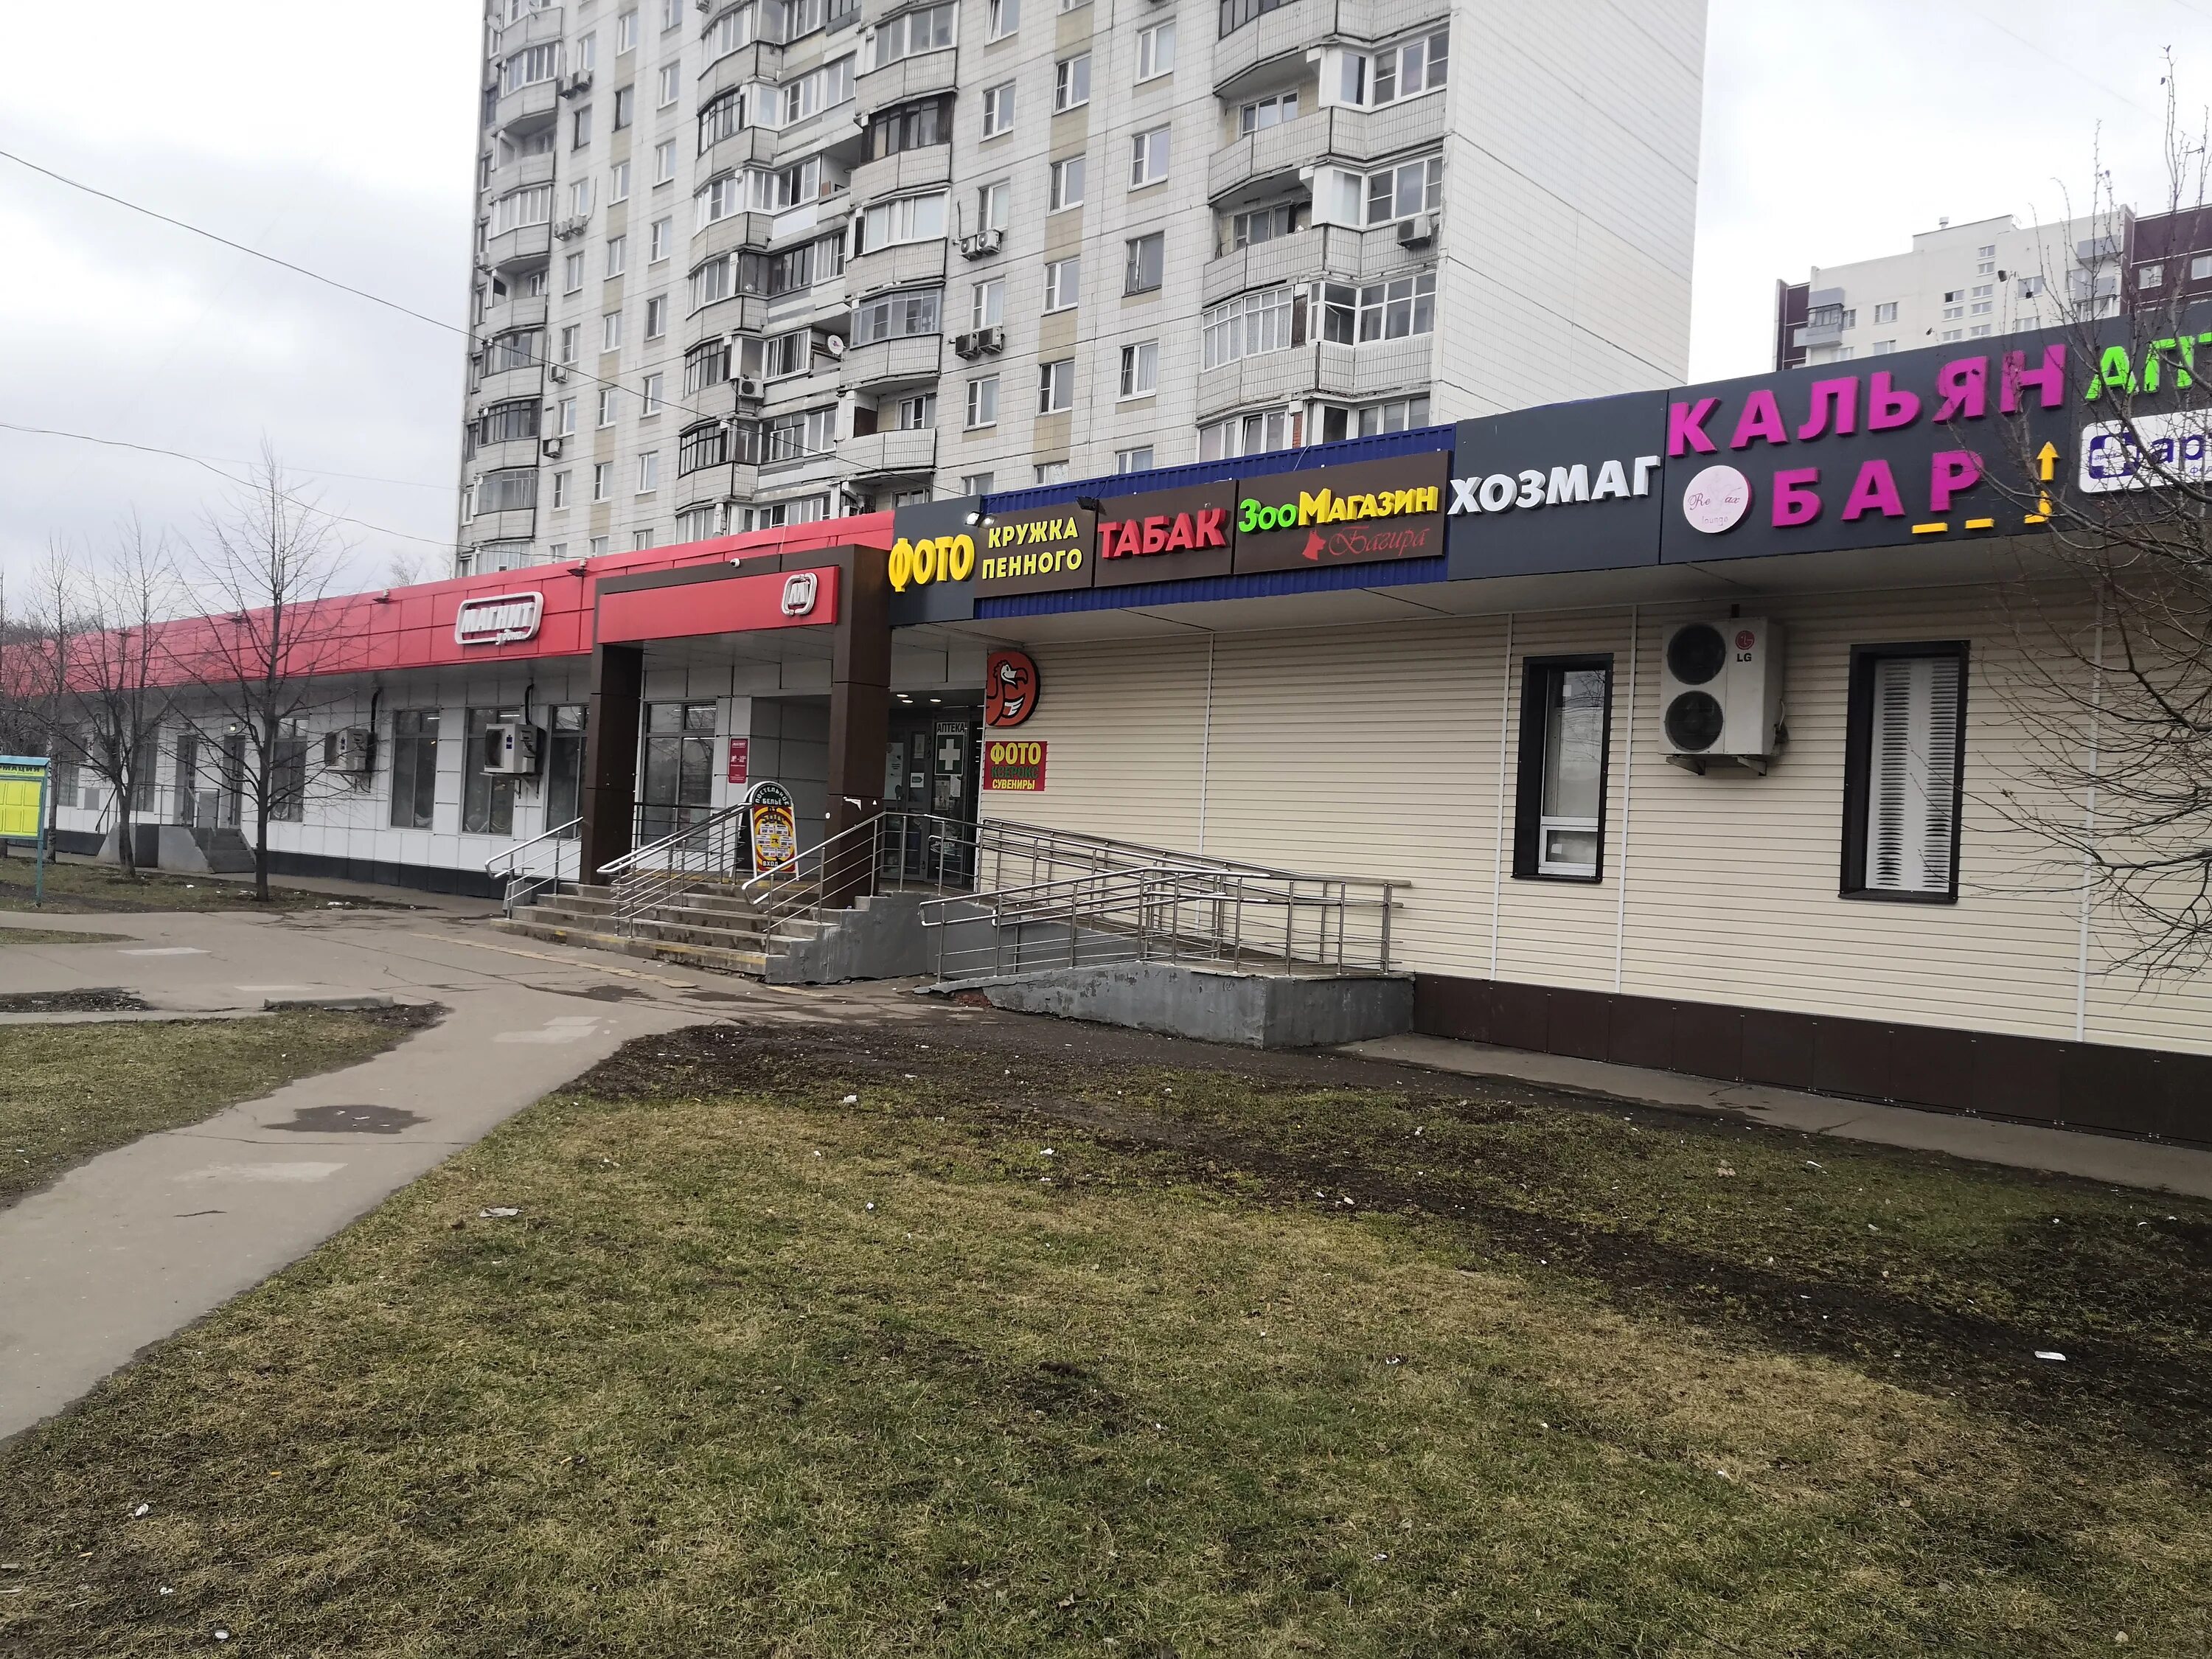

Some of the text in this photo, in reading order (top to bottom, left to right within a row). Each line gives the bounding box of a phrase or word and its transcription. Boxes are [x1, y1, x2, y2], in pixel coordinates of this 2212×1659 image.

[2084, 332, 2212, 401] АП
[1666, 344, 2067, 458] КАЛЬЯН
[1447, 455, 1661, 516] ХОЗМАГ
[1771, 449, 1986, 529] БАР
[988, 516, 1079, 549] КРУЖКА
[1097, 507, 1231, 560] ТАБАК
[1702, 515, 1729, 526] lounge
[1328, 524, 1430, 557] Багира
[888, 533, 975, 593] ФОТО
[981, 548, 1083, 580] ПЕННОГО
[459, 601, 536, 633] МАГНИТ
[1736, 653, 1752, 662] LG
[936, 723, 965, 733] АПТЕКА
[990, 742, 1042, 765] ФОТО
[991, 765, 1040, 779] КСЕРОКС
[992, 779, 1036, 790] СУВЕНИРЫ
[754, 786, 790, 806] ПОСТЕЛЬНОЕ
